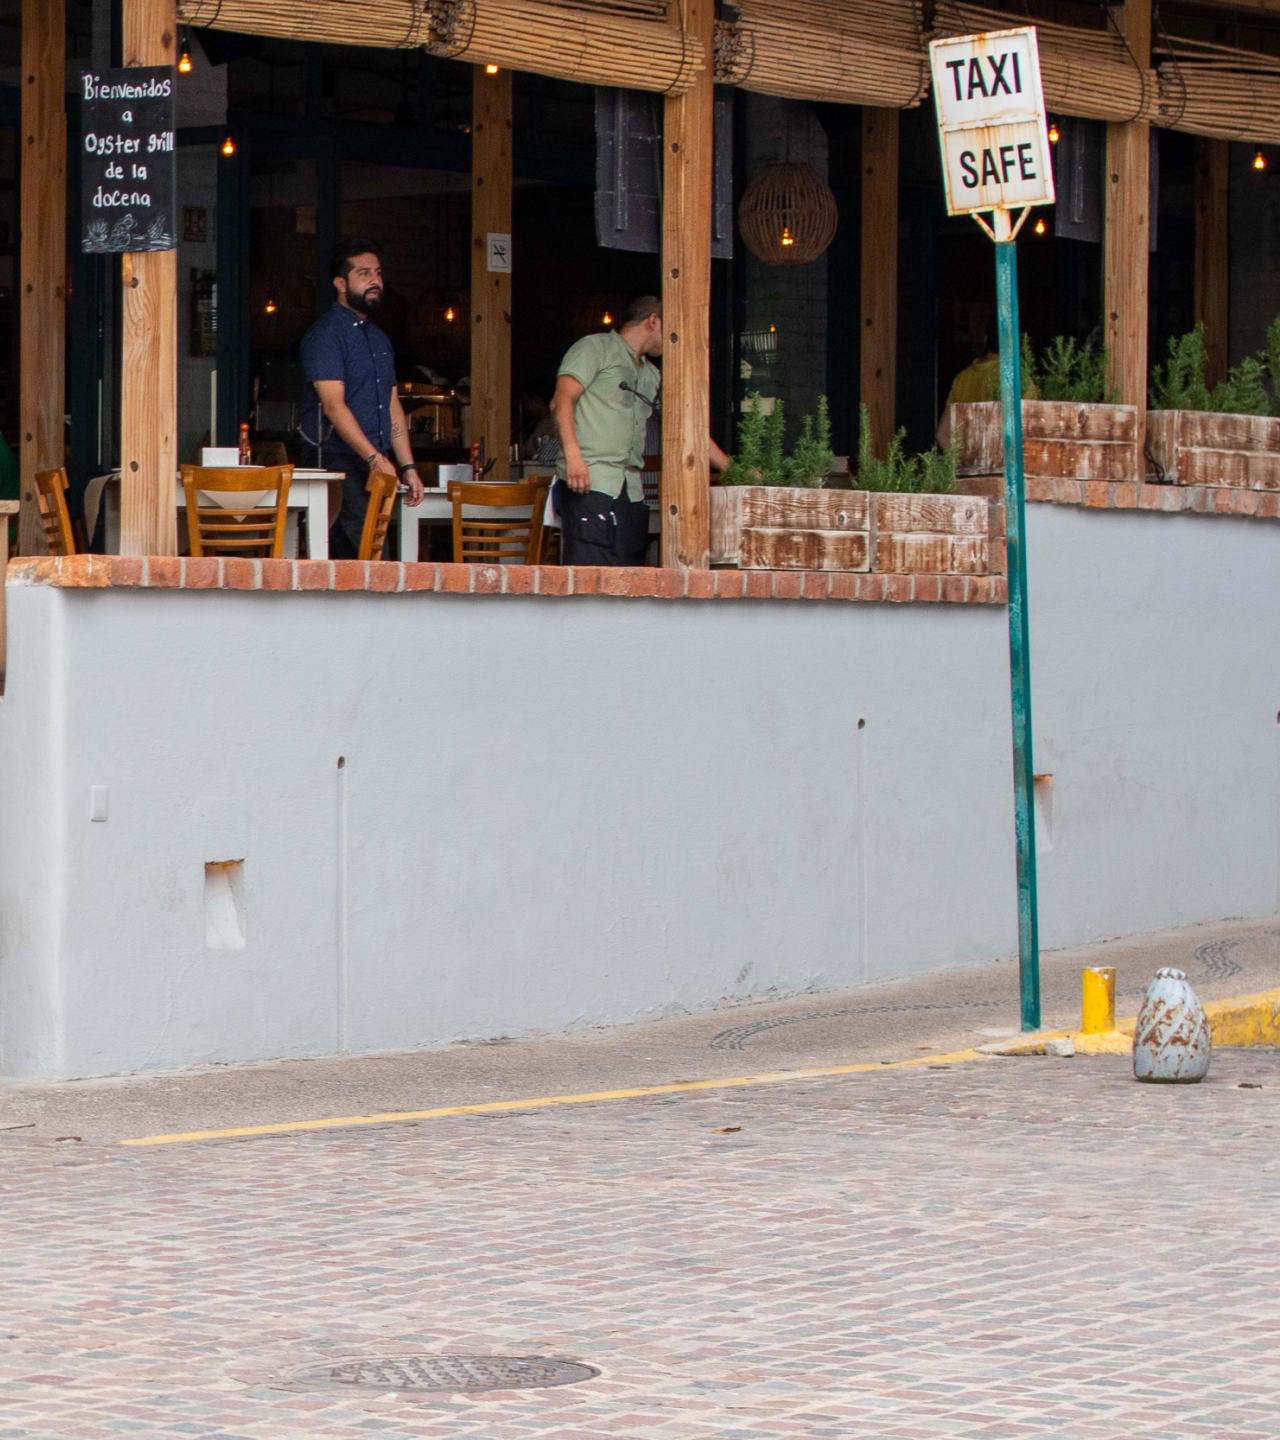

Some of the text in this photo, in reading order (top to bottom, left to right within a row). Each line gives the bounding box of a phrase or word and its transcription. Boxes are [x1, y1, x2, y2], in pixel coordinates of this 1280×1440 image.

[81, 73, 173, 101] Bienvenidos
[945, 51, 1023, 102] TAXI
[121, 110, 134, 123] a
[85, 131, 175, 155] Oyster grill
[104, 161, 148, 180] de la
[959, 142, 1037, 190] SAFE
[92, 184, 152, 208] docena
